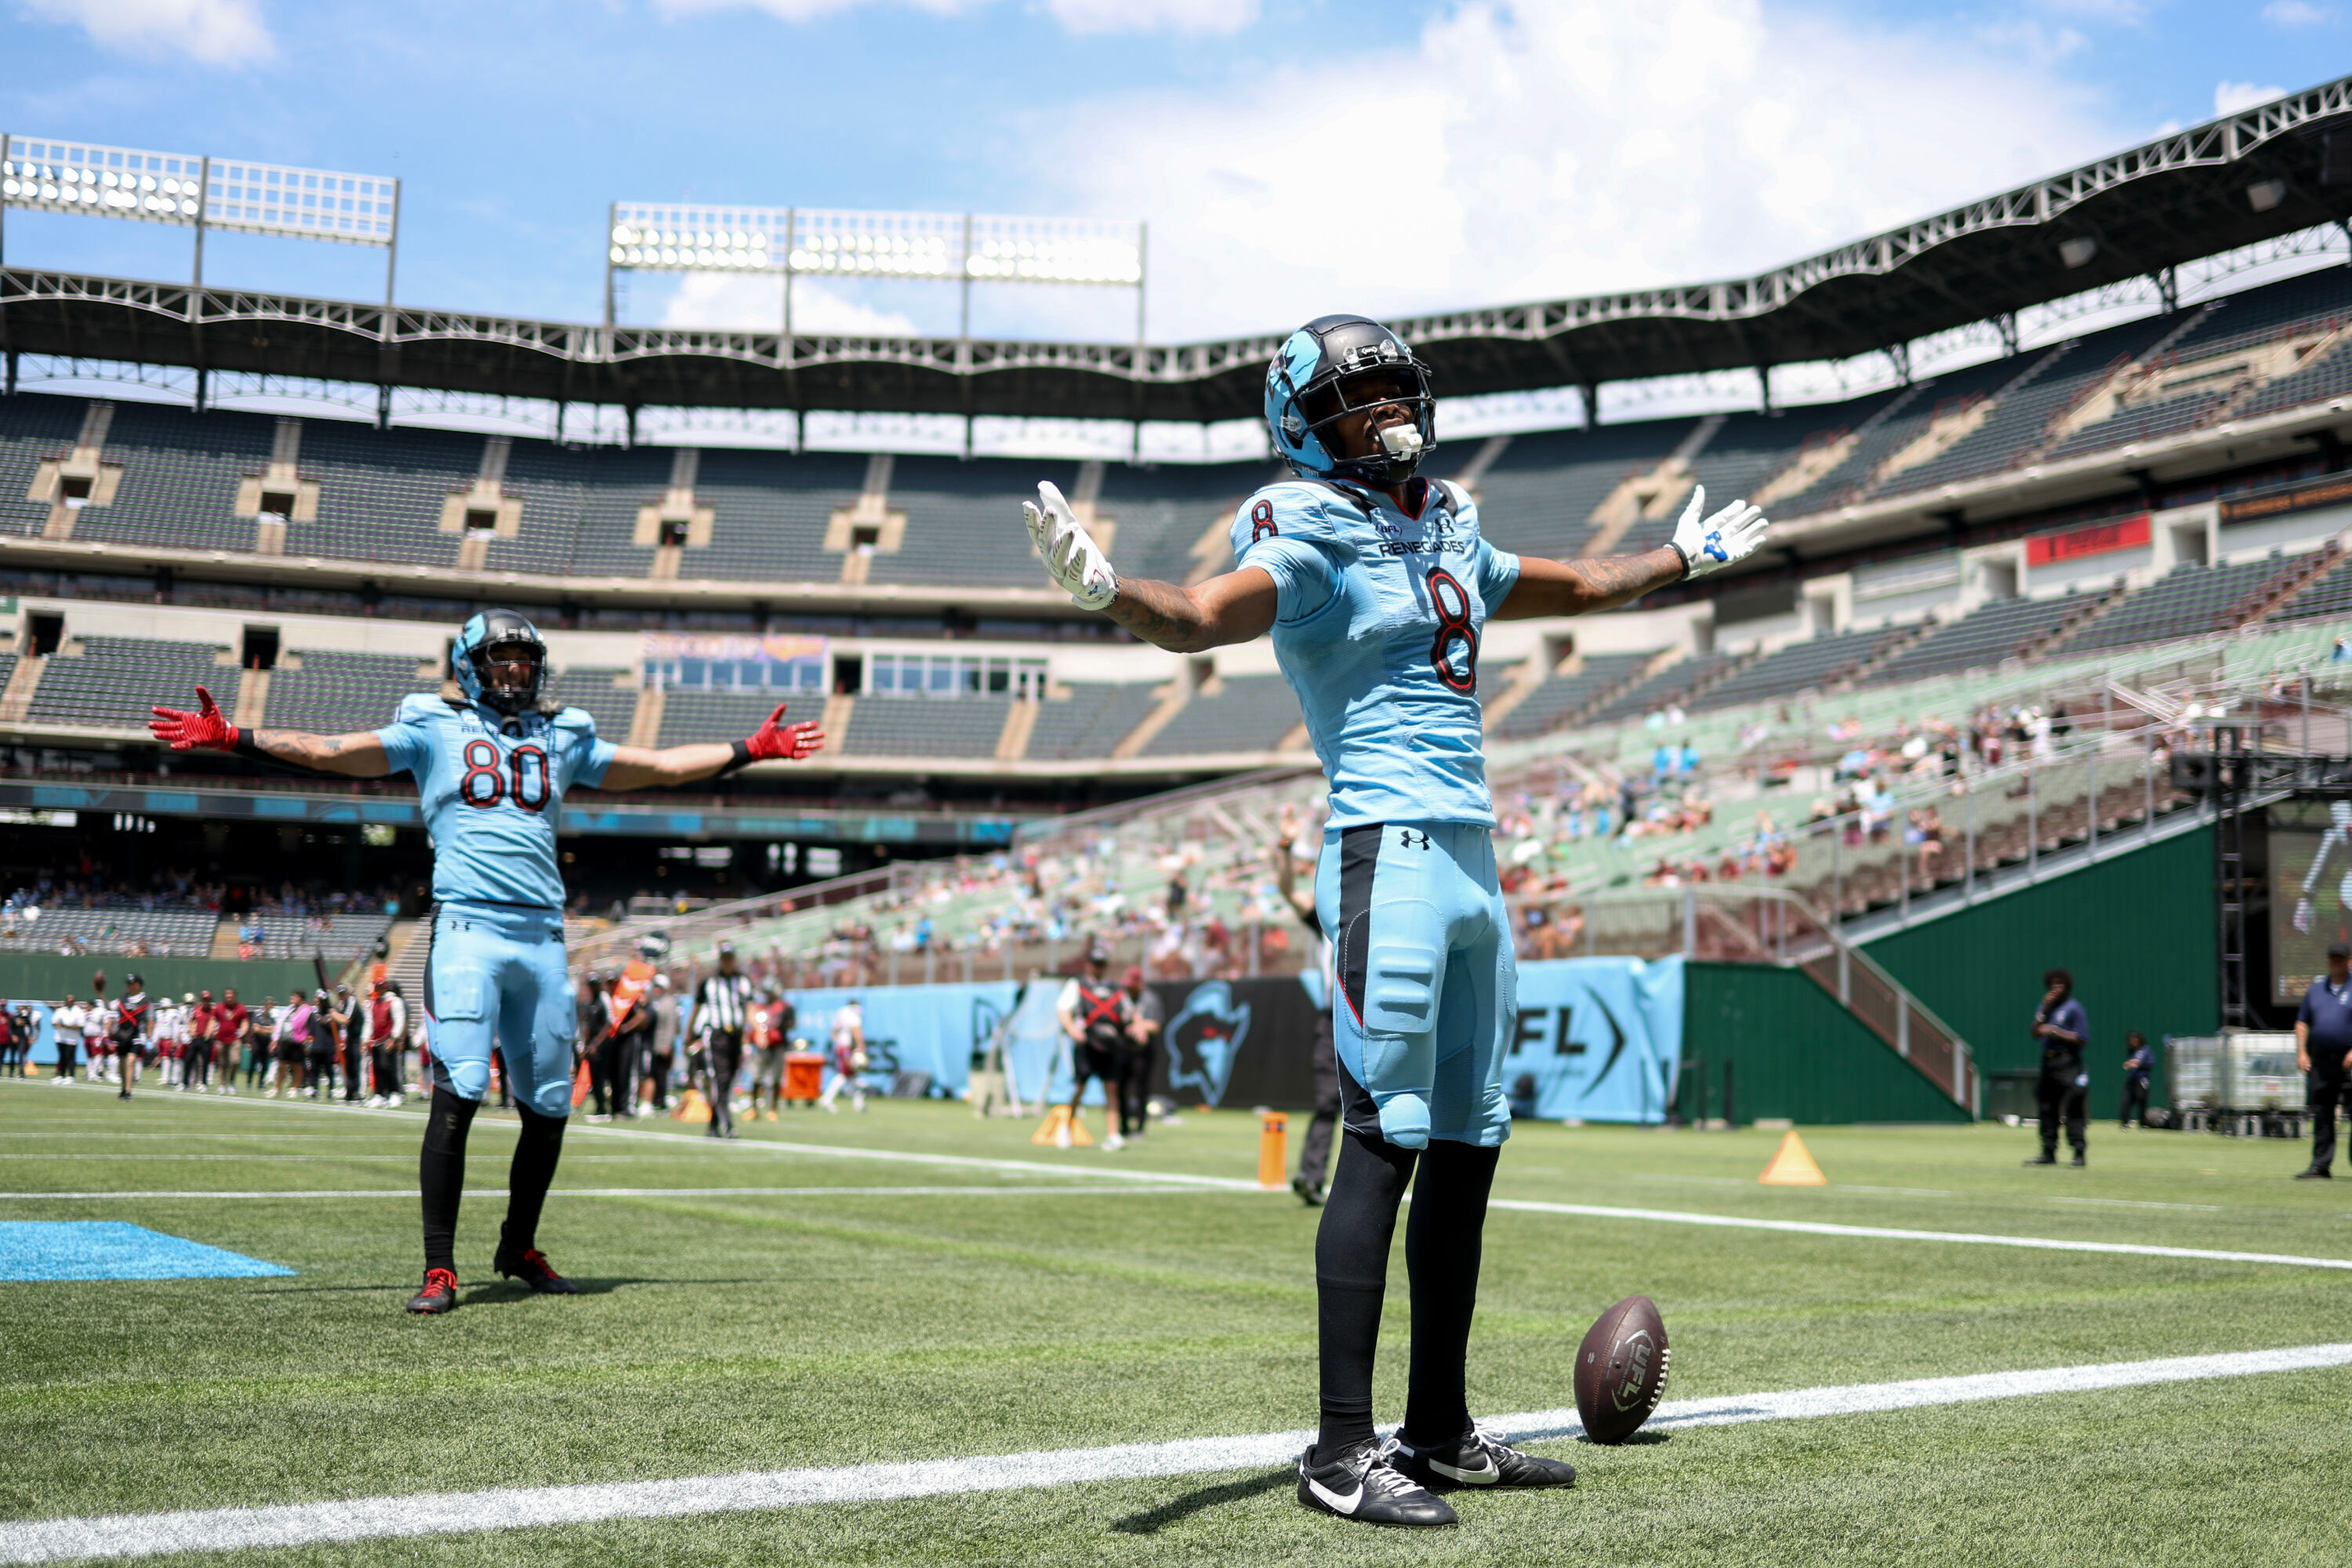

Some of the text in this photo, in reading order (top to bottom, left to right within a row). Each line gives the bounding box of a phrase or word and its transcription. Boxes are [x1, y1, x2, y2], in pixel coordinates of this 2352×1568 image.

[1251, 499, 1279, 543] 8
[1379, 541, 1465, 557] RENEGADES
[1426, 567, 1476, 697] 8
[460, 739, 551, 811] 80
[1511, 1007, 1586, 1054] FL
[1622, 1344, 1651, 1398] UFL
